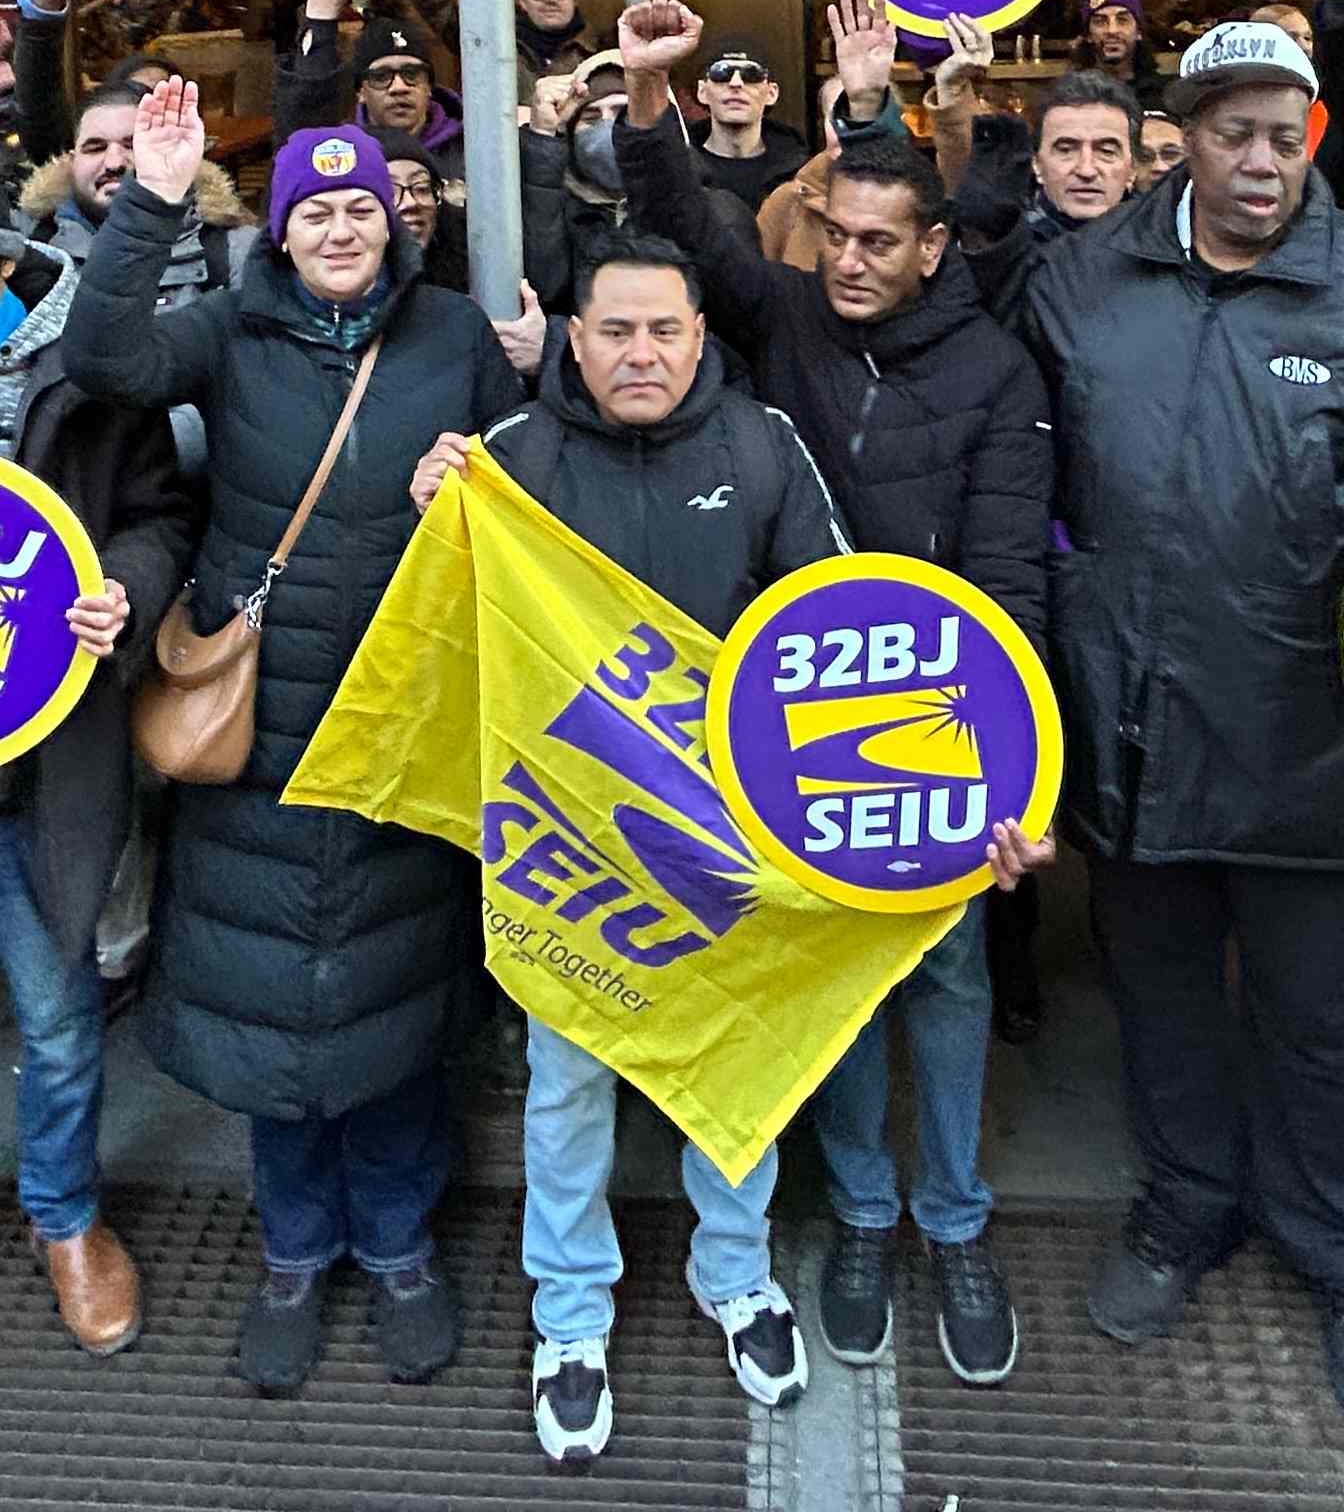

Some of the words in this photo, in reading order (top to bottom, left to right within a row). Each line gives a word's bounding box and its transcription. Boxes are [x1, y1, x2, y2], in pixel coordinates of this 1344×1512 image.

[595, 622, 710, 768] 32
[773, 616, 960, 693] 32BJ
[803, 784, 989, 853] SEIU
[483, 801, 713, 968] SEIU
[537, 929, 653, 1012] Together
